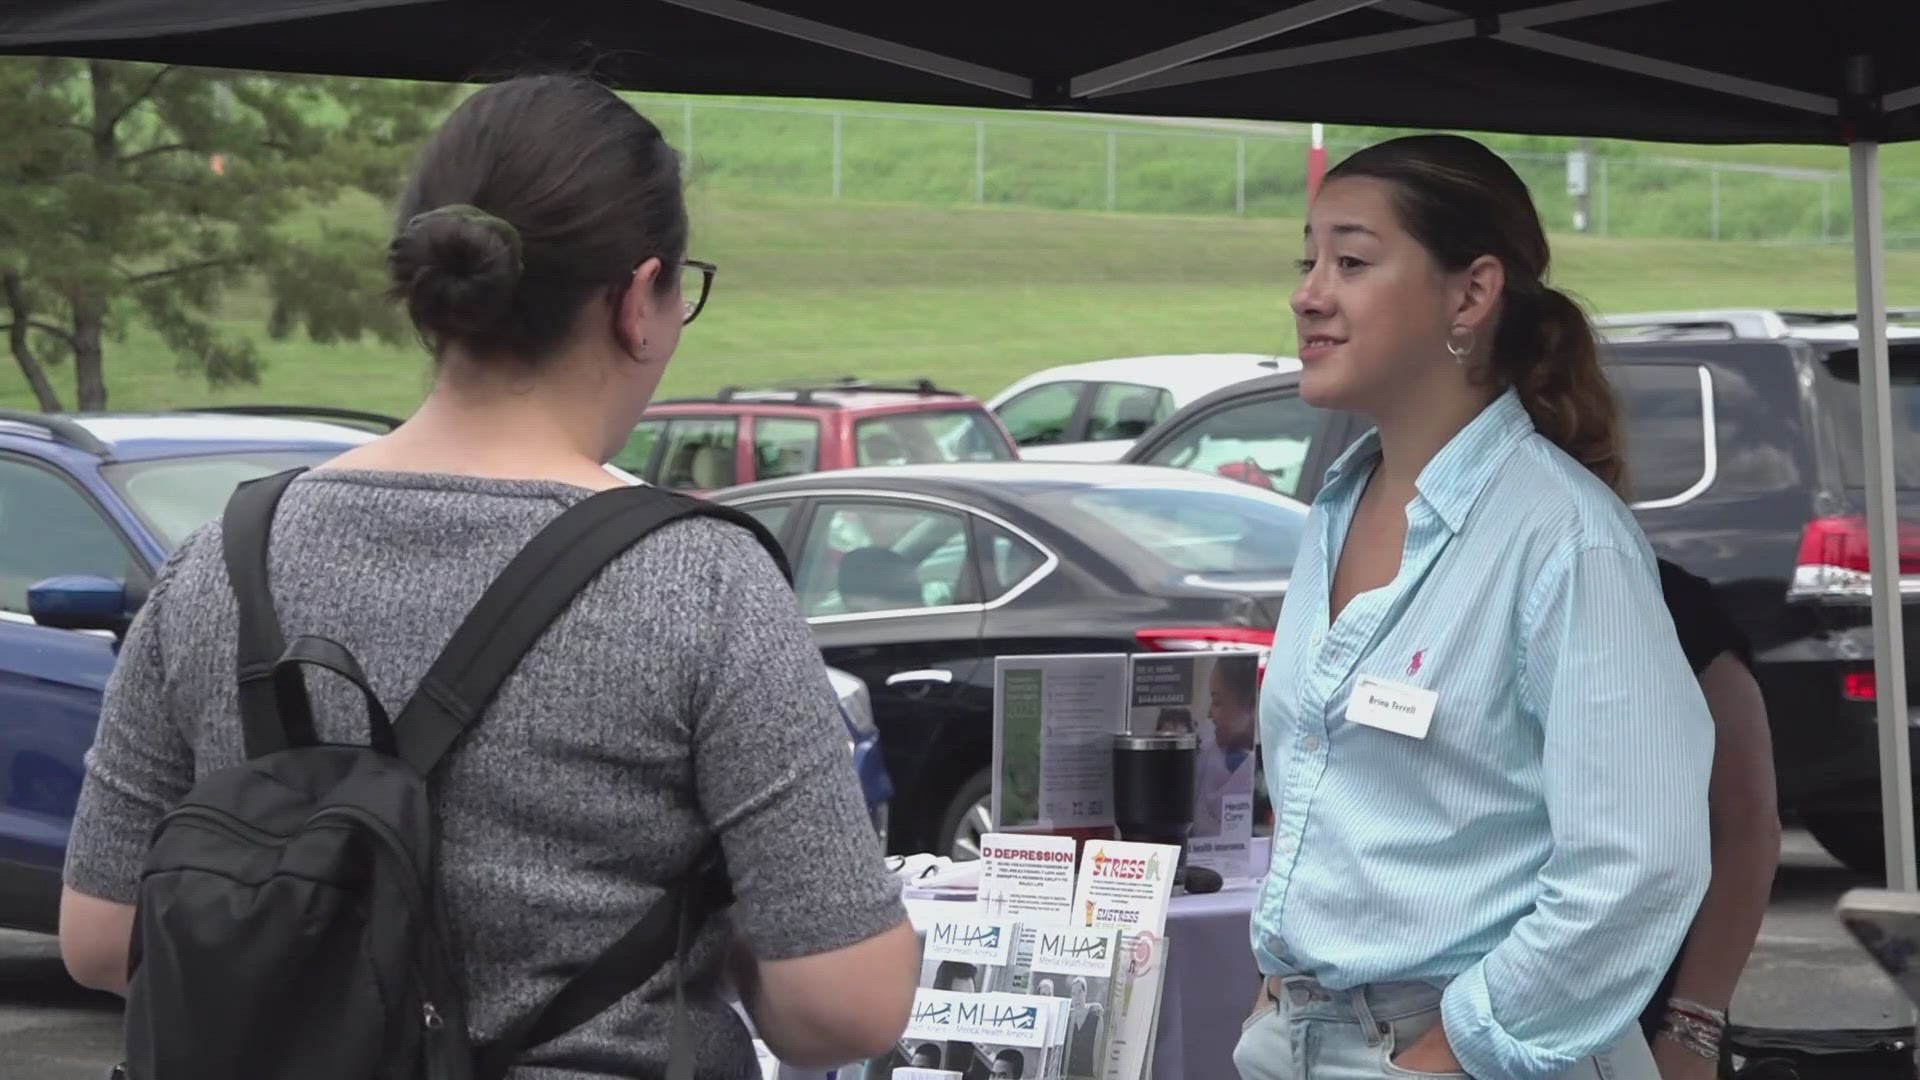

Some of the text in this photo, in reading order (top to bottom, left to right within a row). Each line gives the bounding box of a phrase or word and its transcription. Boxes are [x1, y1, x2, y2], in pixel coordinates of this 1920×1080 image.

[994, 848, 1074, 863] DEPRESSION
[1092, 857, 1146, 880] STRESS
[933, 922, 983, 947] MHA
[1040, 933, 1091, 959] MHA
[957, 1001, 1016, 1029] MHA
[981, 1027, 1004, 1036] Health
[1005, 1028, 1034, 1039] America
